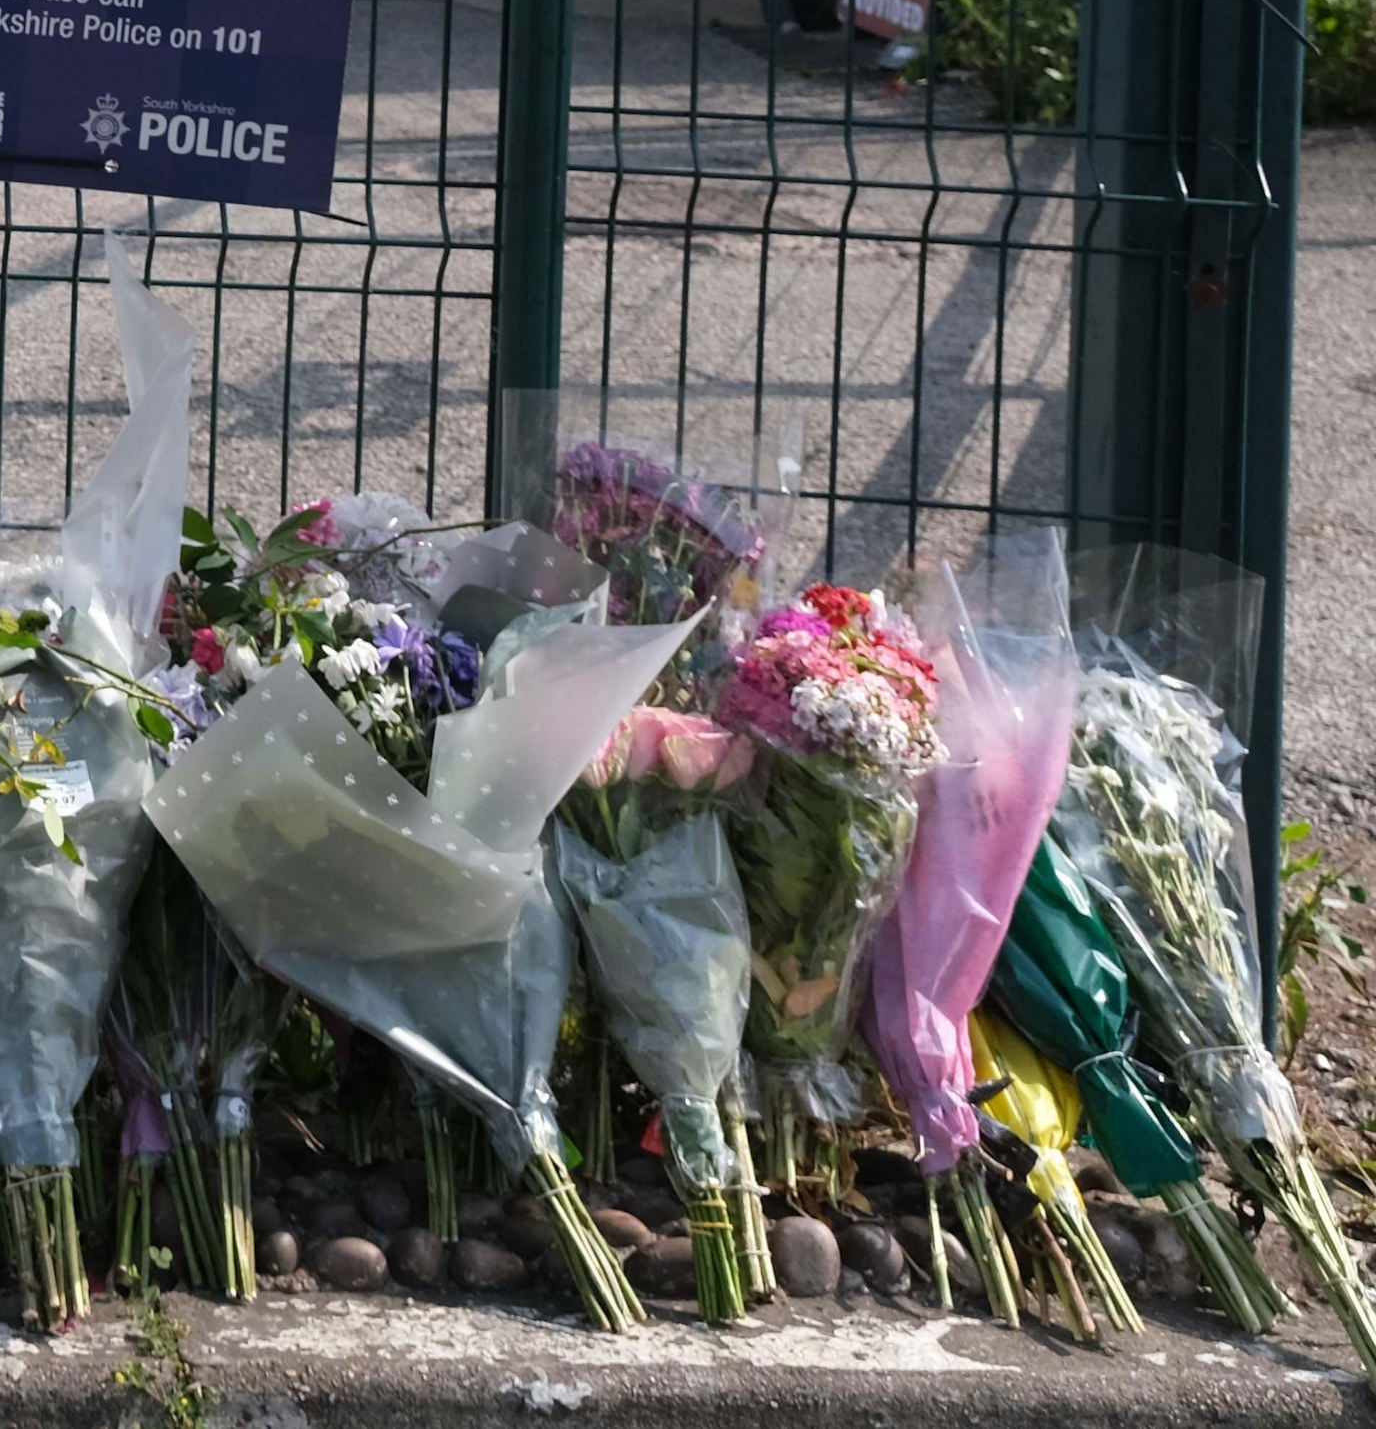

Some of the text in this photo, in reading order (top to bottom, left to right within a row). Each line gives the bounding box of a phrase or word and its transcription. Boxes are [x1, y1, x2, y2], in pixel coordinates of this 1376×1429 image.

[82, 14, 162, 46] Police
[169, 28, 202, 50] on
[212, 26, 262, 56] 101
[142, 95, 236, 116] South Yorkshire
[138, 111, 289, 165] POLICE
